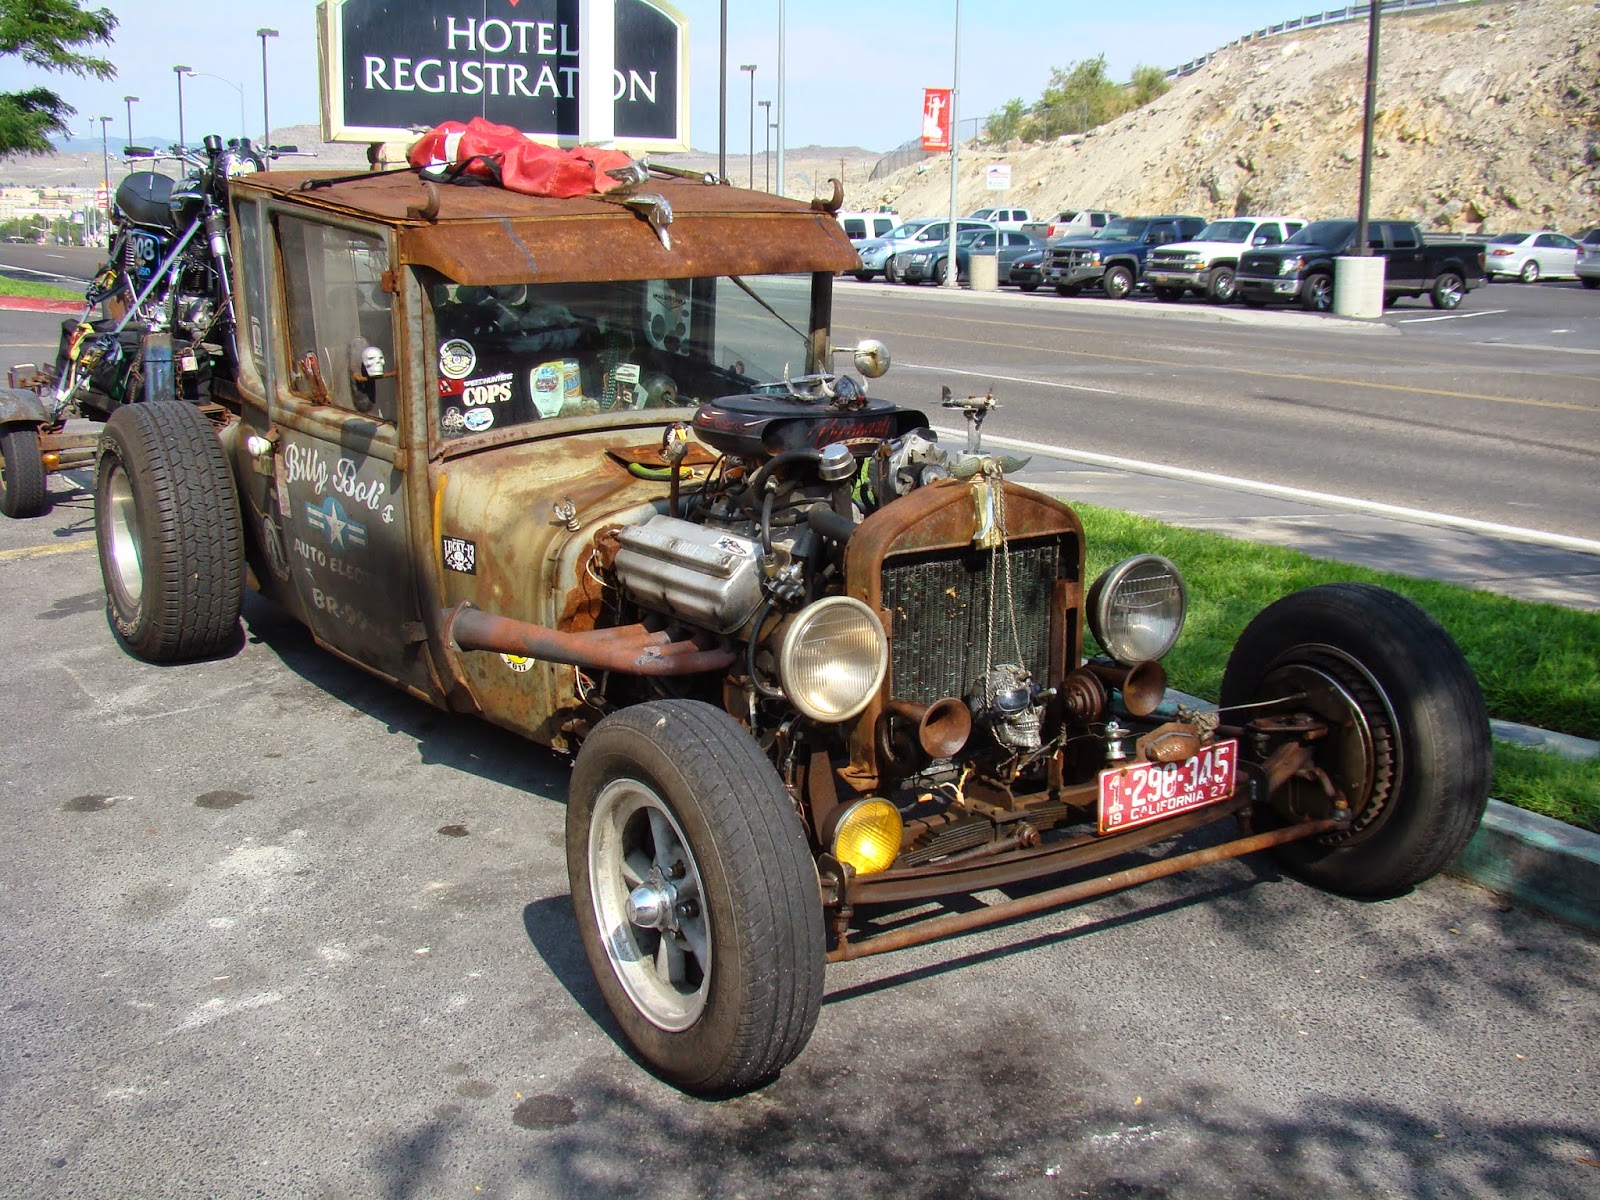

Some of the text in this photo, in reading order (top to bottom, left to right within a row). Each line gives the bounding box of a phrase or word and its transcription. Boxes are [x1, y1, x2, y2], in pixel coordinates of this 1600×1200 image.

[446, 16, 579, 56] HOTEL
[363, 55, 658, 104] REGISTRATN
[462, 381, 513, 407] COPS
[285, 442, 328, 495] Billy
[294, 538, 326, 567] AUTO
[1108, 783, 1227, 826] 19 CALIFORNIA 27
